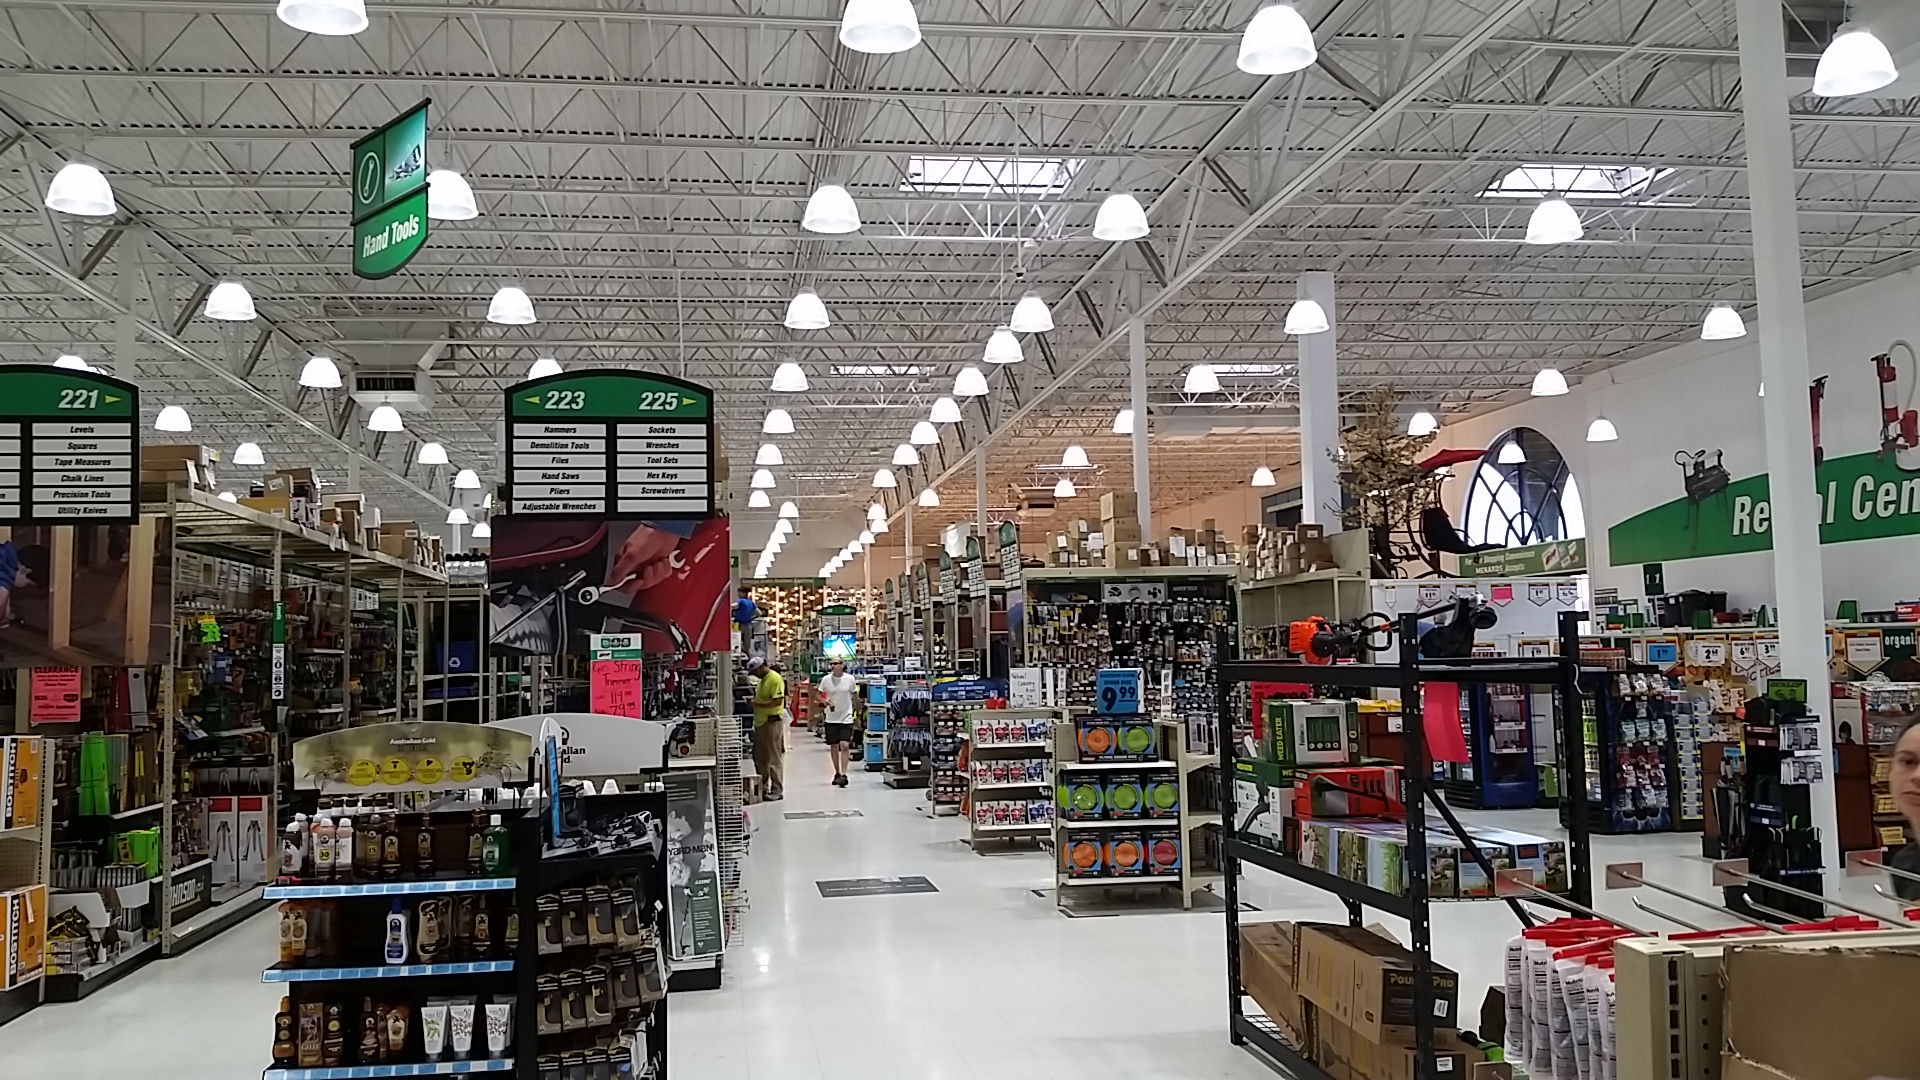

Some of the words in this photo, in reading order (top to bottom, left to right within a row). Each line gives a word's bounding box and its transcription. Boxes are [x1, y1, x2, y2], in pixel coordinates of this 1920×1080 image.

[362, 226, 389, 258] Hand
[391, 214, 419, 245] Tools
[58, 389, 98, 409] 221
[544, 390, 585, 410] 223
[639, 391, 679, 411] 225
[69, 425, 95, 434] Levels
[544, 425, 577, 434] Hammers
[648, 425, 676, 434] Sockets
[67, 441, 98, 452] Squares
[530, 441, 569, 450] Demolition
[570, 441, 590, 450] Tools
[645, 441, 680, 450] Wrenches
[54, 457, 74, 468] Tape
[75, 457, 111, 467] Measures
[551, 456, 569, 465] Files
[646, 456, 662, 465] Tool
[663, 456, 679, 465] Sets
[61, 474, 82, 483] Chalk
[84, 474, 104, 483] Lines
[541, 472, 560, 480] Hand
[562, 472, 580, 480] Saws
[646, 471, 660, 480] Hex
[661, 471, 678, 481] Keys
[53, 490, 89, 499] Precision
[91, 490, 111, 499] Tools
[549, 486, 570, 496] Pliers
[640, 486, 686, 495] Screwdrivers
[57, 505, 81, 516] Utility
[82, 505, 108, 515] Knives
[522, 502, 561, 512] Adjustable
[562, 502, 597, 511] Wrenches
[1464, 557, 1473, 566] For
[1475, 564, 1503, 574] MENARDS
[34, 666, 79, 674] CLEARANCE
[614, 661, 641, 680] String
[602, 673, 632, 686] Trimmer
[1102, 686, 1117, 712] 9
[1119, 686, 1136, 699] 99
[1275, 717, 1284, 740] EATER
[1276, 740, 1285, 761] WEED
[6, 743, 18, 818] BOSTITCH
[9, 898, 20, 976] BOSTITCH
[1431, 976, 1454, 988] PRO
